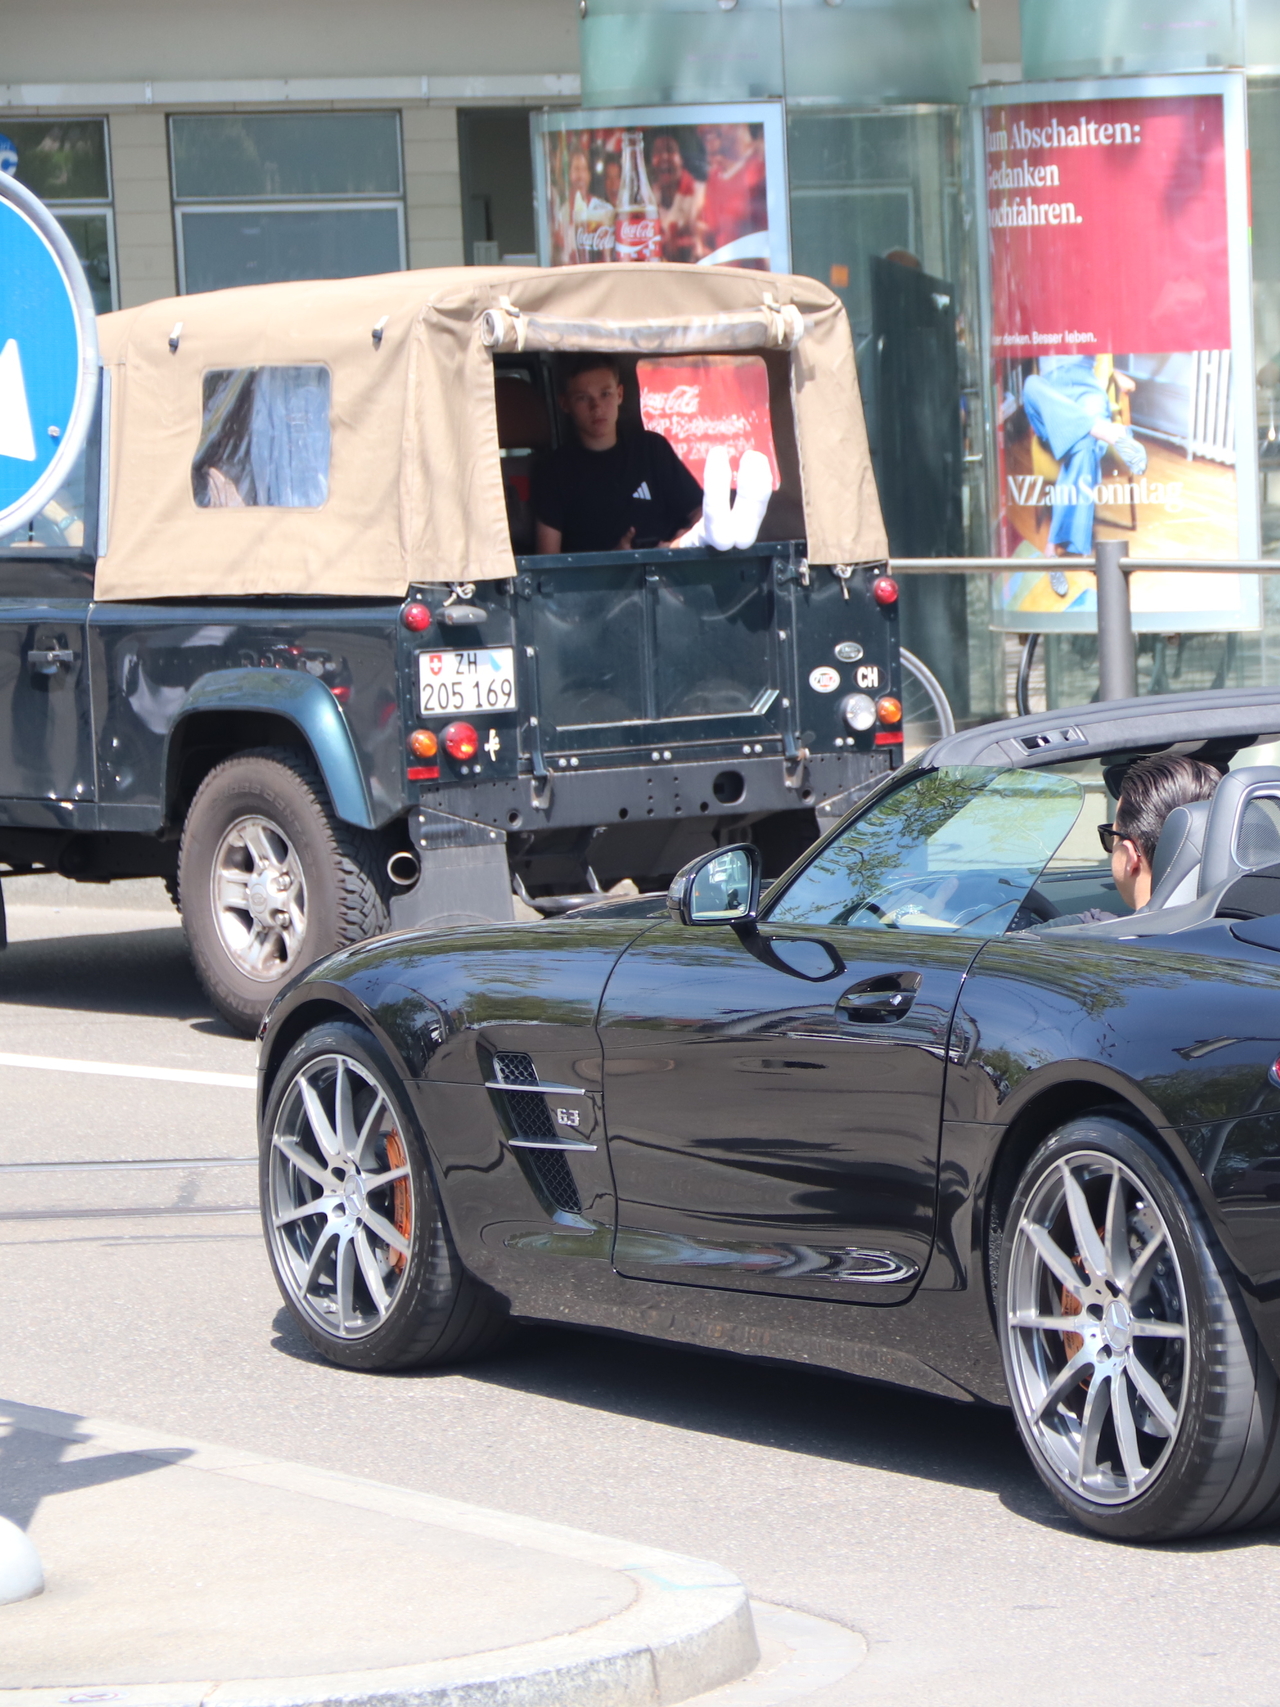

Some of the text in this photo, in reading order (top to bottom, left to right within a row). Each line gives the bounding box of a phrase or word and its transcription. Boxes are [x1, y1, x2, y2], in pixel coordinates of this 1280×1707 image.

[1010, 116, 1141, 151] Abschalten:
[1032, 331, 1063, 345] Besser
[1064, 329, 1098, 343] leben.
[455, 652, 478, 675] ZH
[857, 666, 879, 688] CH
[422, 678, 513, 711] 205 169
[557, 1108, 579, 1127] 63
